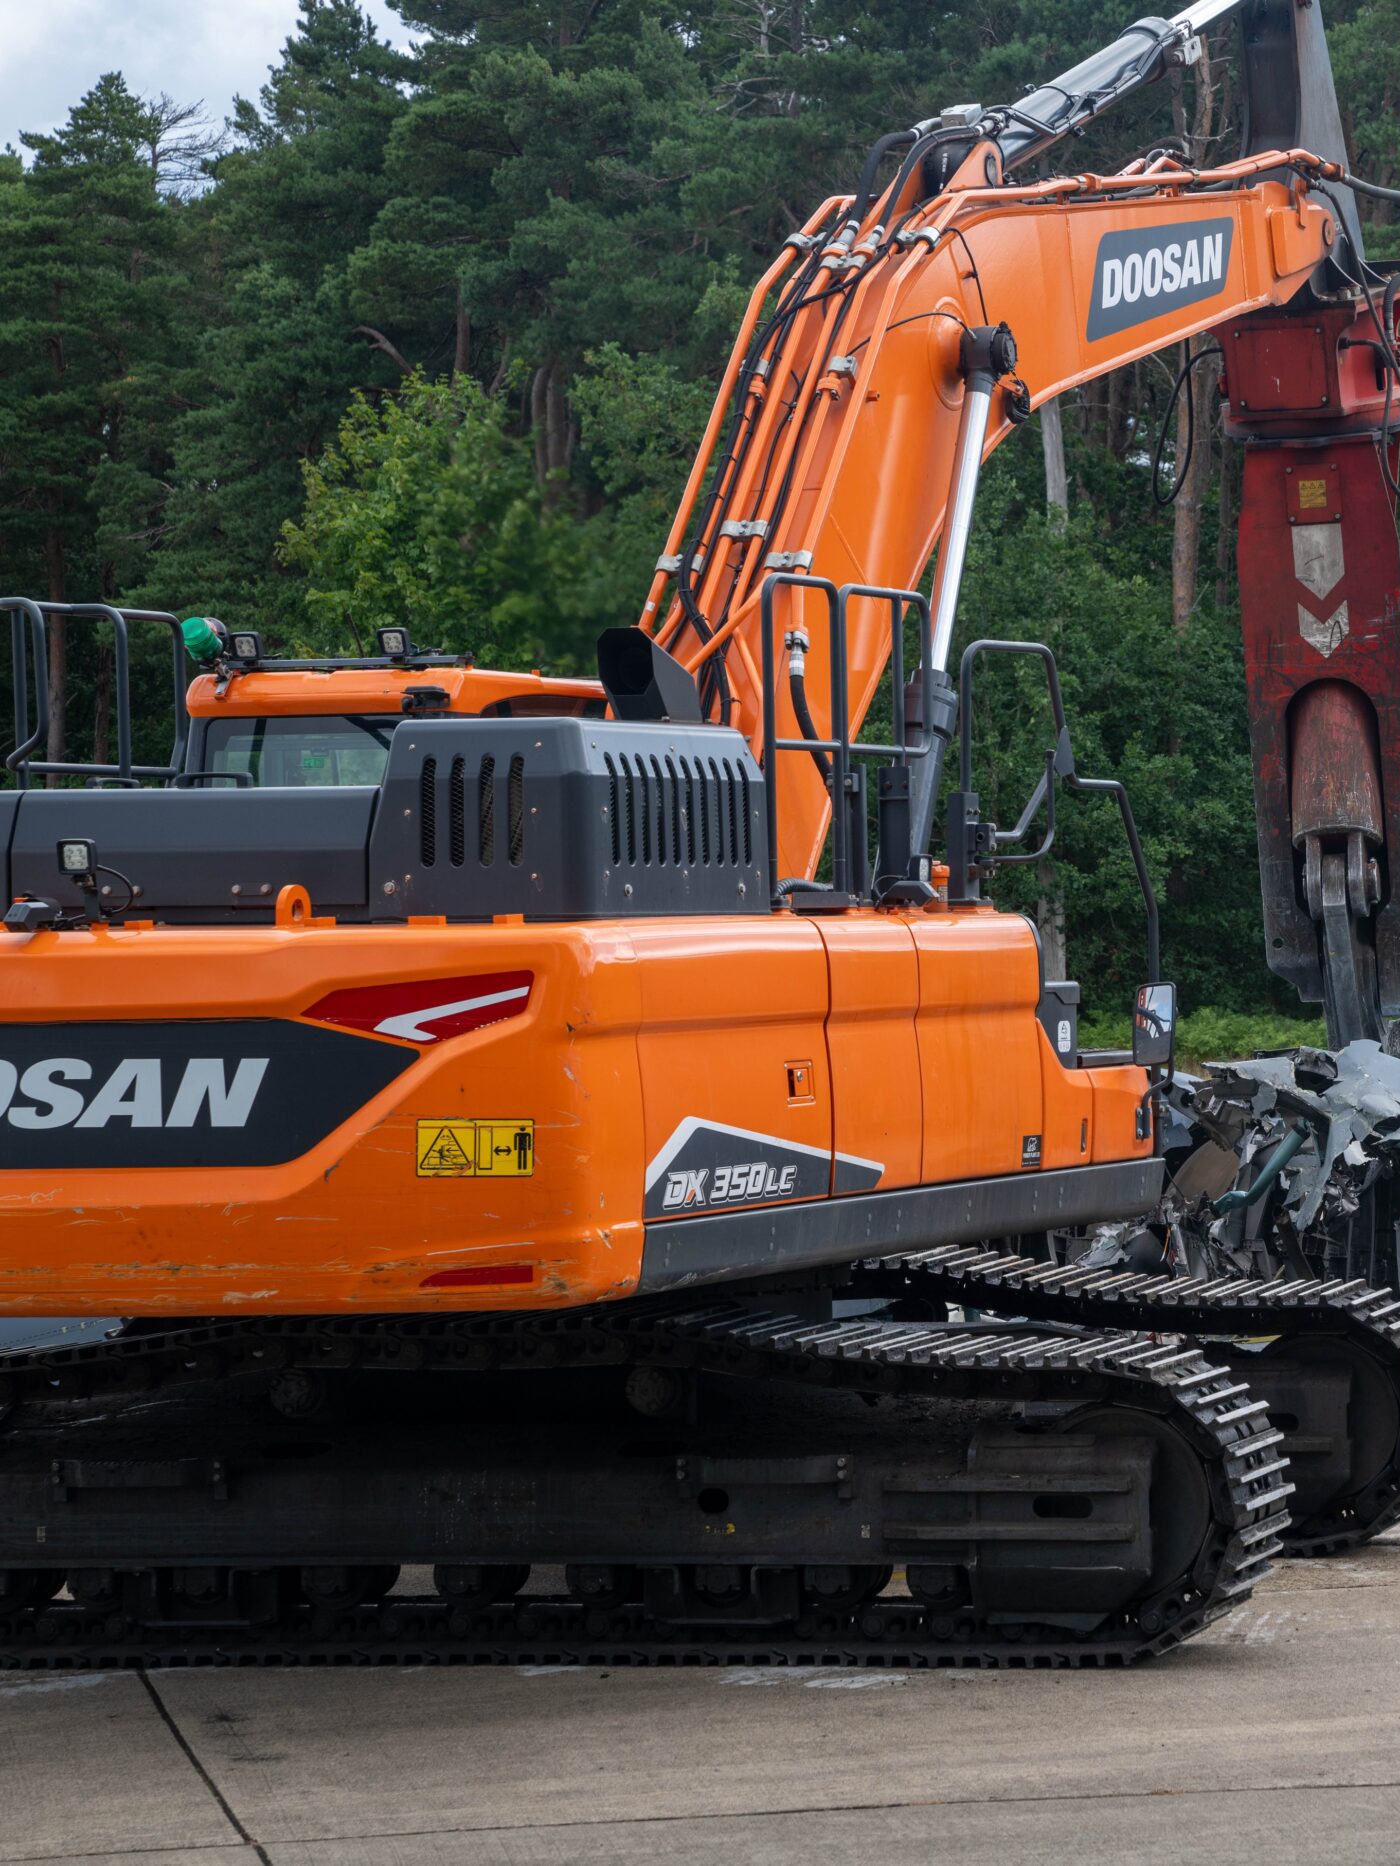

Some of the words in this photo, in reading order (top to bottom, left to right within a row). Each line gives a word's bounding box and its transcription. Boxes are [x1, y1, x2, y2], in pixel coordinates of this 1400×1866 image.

[1102, 232, 1223, 309] DOOSAN
[0, 1057, 270, 1129] SAN
[663, 1168, 709, 1210] DX
